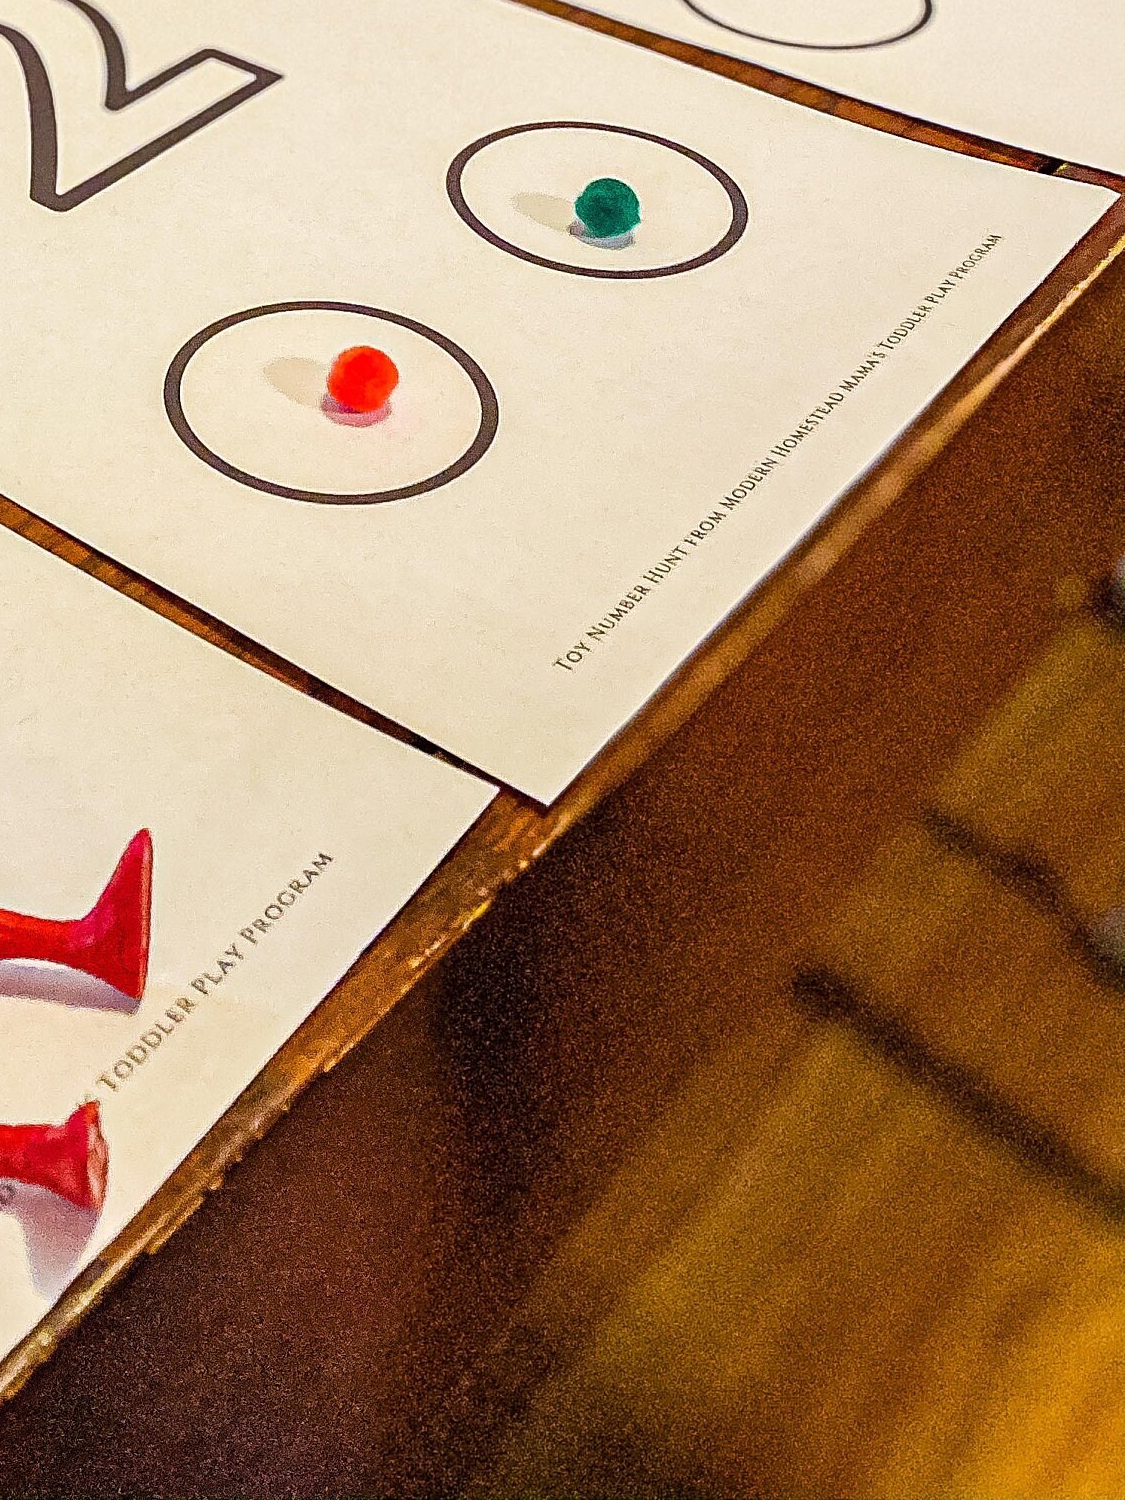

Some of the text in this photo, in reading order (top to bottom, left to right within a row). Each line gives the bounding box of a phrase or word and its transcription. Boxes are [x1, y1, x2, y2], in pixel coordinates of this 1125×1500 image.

[553, 234, 1003, 671] TOY NUMBER HUNT FROM MODERN HOMESTEAD MAMA'S TODDLER PLAY PROGRAM
[96, 996, 196, 1093] TODDLER
[190, 943, 244, 995] PLAY
[238, 852, 334, 945] PROGRAM
